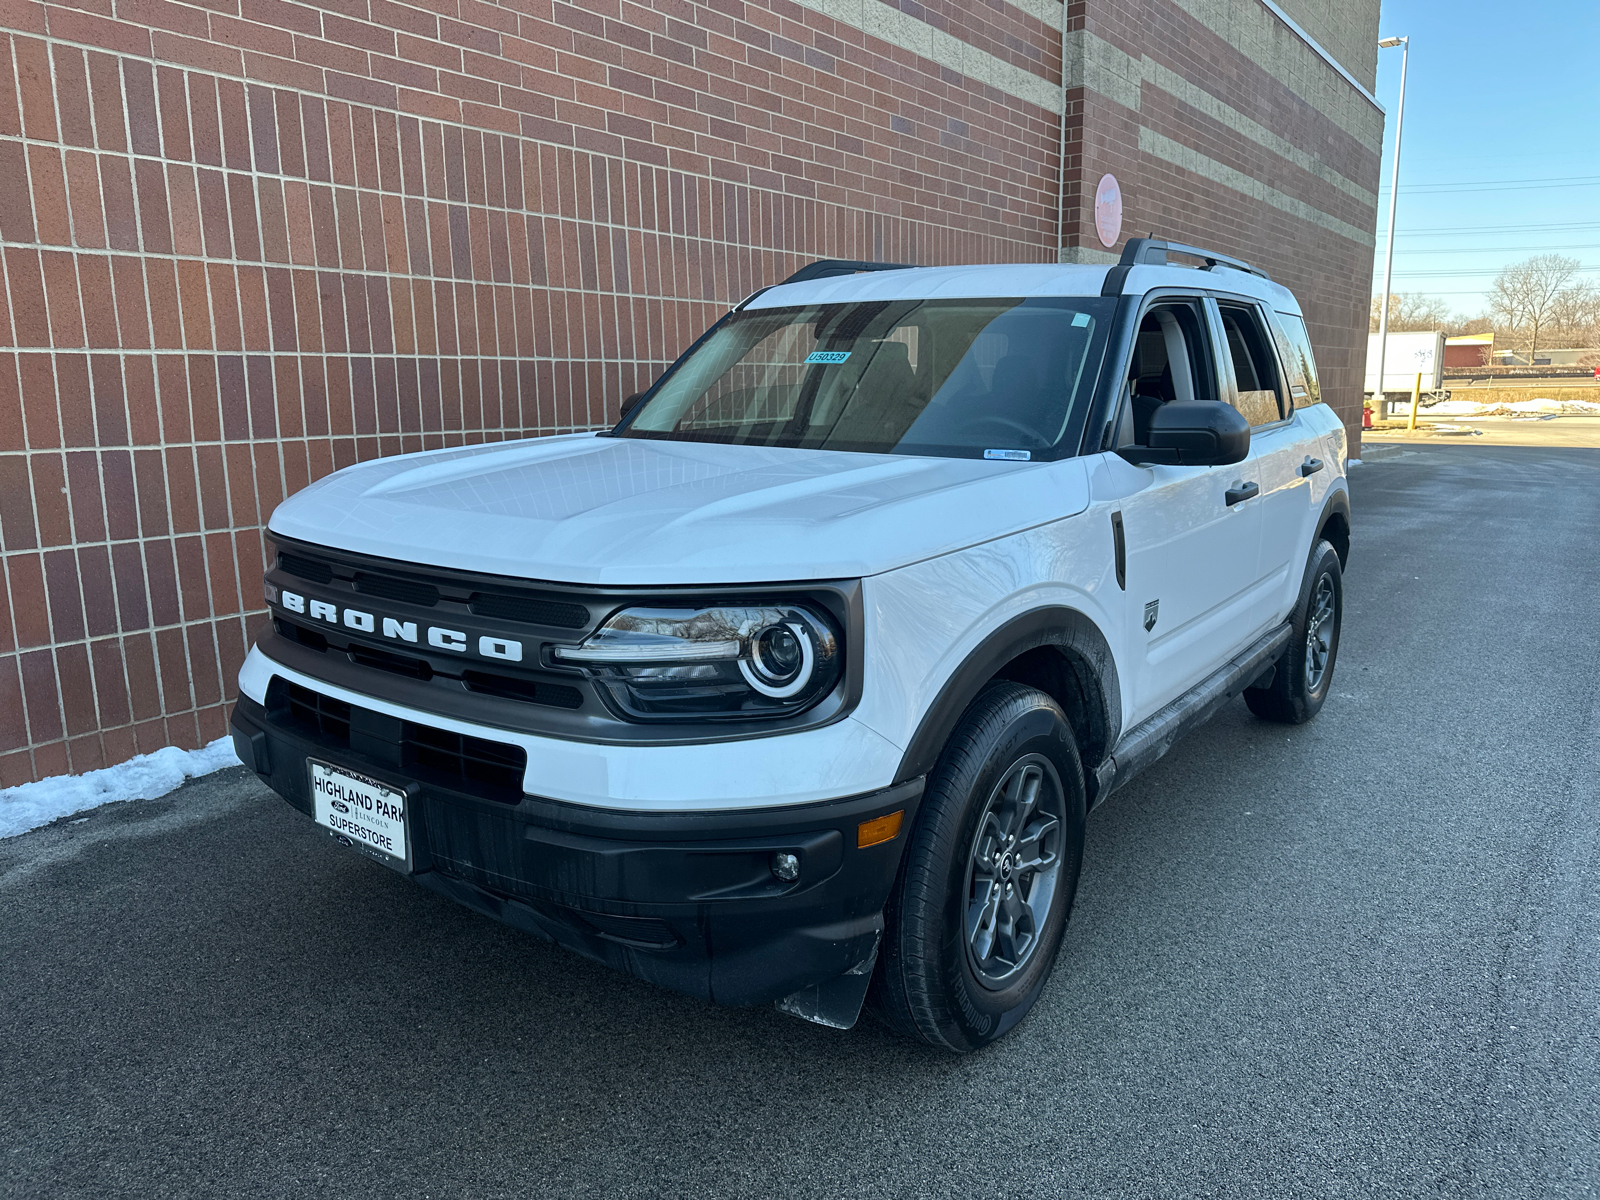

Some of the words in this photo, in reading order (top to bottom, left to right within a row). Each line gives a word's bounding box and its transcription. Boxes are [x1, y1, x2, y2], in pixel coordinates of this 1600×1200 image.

[808, 353, 846, 361] U50329
[282, 590, 523, 662] BRONCO
[314, 775, 373, 811] HIGHLAND
[376, 799, 404, 823] PARK
[329, 813, 393, 851] SUPERSTORE
[359, 811, 389, 830] LINCOLN
